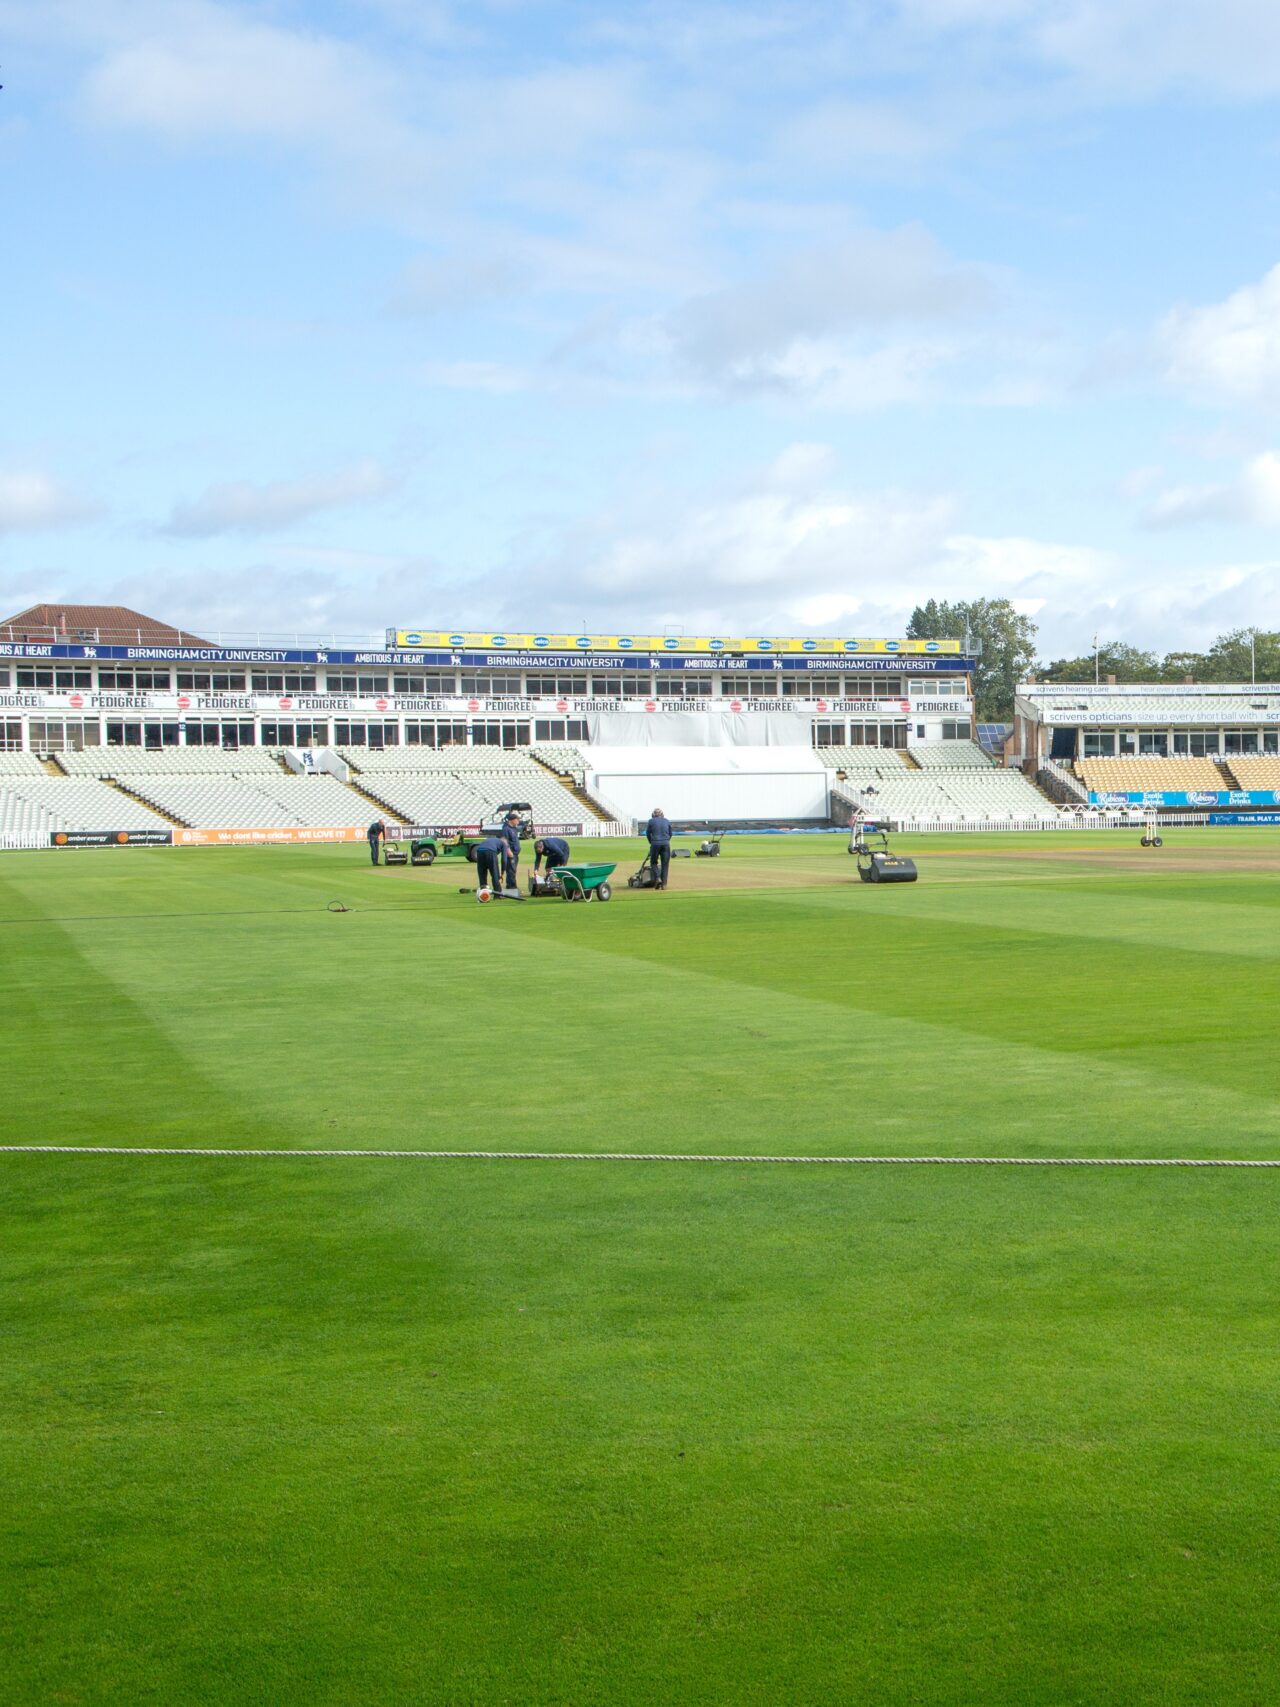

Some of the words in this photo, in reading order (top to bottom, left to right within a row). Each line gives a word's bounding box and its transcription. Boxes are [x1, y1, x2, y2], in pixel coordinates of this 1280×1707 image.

[14, 646, 24, 655] AT
[26, 646, 52, 656] HEART
[128, 648, 201, 660] BIRMINGHAM
[202, 650, 224, 660] CITY
[226, 650, 287, 661] UNIVERSITY
[354, 654, 392, 664] AMBITIOUS
[393, 654, 402, 664] AT
[403, 654, 424, 664] HEART
[487, 656, 546, 666] BIRMINGHAM
[548, 657, 568, 666] CITY
[570, 658, 624, 668] UNIVERSITY
[684, 660, 717, 668] AMBITIOUS
[719, 660, 726, 668] AT
[728, 660, 748, 669] HEART
[808, 660, 864, 669] BIRMINGHAM
[866, 661, 884, 669] CITY
[886, 661, 936, 669] UNIVERSITY
[1066, 686, 1092, 694] hearing
[92, 697, 147, 708] PEDIGREE
[198, 698, 250, 708] PEDIGREE
[298, 700, 352, 710] PEDIGREE
[394, 700, 442, 710] PEDIGREE
[486, 701, 530, 710] PEDIGREE
[574, 702, 618, 711] PEDIGREE
[662, 702, 706, 711] PEDIGREE
[747, 702, 791, 711] PEDIGREE
[833, 702, 876, 711] PEDIGREE
[916, 702, 960, 712] PEDIGREE
[1050, 712, 1088, 720] scrivens
[1089, 712, 1132, 722] opticians
[1156, 714, 1167, 722] up
[1170, 714, 1194, 722] every
[1221, 712, 1236, 720] ball
[1238, 712, 1257, 720] with
[1098, 792, 1126, 803] Rubicon
[1188, 792, 1216, 804] Rubicon
